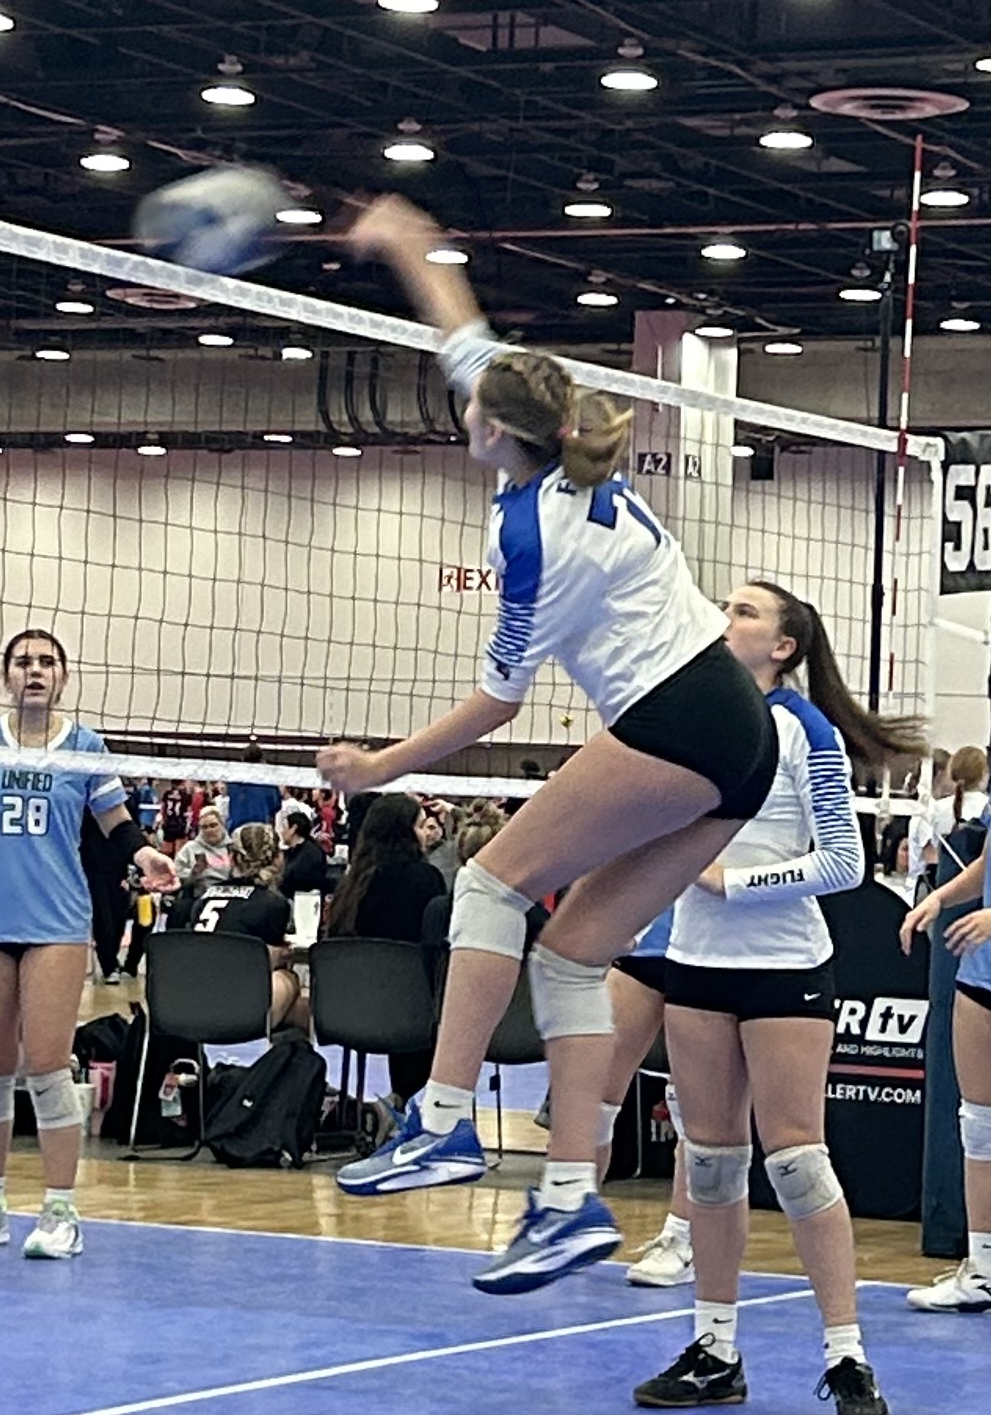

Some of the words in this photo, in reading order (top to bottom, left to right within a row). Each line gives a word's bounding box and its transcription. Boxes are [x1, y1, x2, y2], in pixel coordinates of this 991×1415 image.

[642, 453, 668, 474] A2
[463, 568, 500, 591] EXI
[1, 794, 50, 836] 28
[747, 868, 806, 888] FLIGHT
[194, 899, 229, 933] 5
[834, 999, 867, 1035] R
[836, 1043, 858, 1055] AND
[825, 1083, 922, 1104] LERTV.COM
